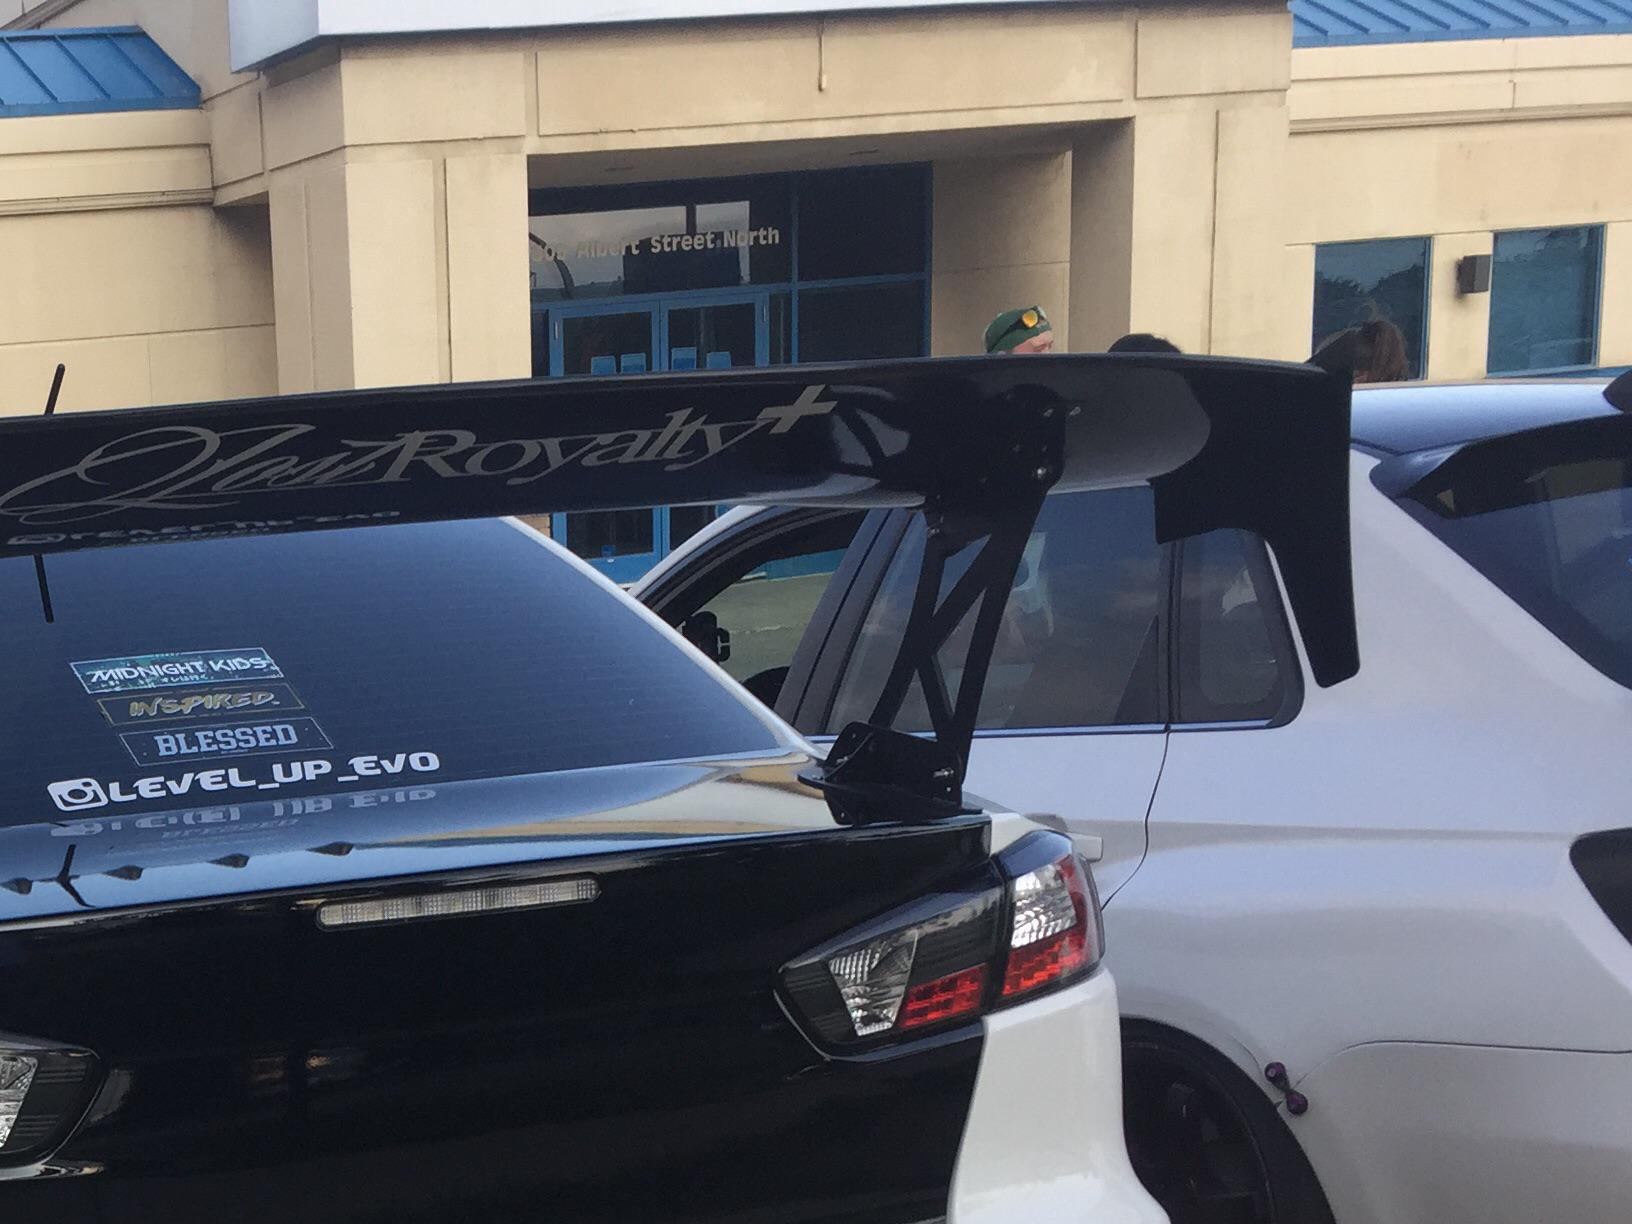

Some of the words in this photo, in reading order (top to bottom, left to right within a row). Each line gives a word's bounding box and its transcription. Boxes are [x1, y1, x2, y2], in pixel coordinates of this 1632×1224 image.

[650, 231, 715, 254] Street
[722, 226, 780, 248] North
[86, 657, 205, 683] MIDNIGHT
[209, 656, 269, 674] KIDS
[153, 724, 299, 757] BLESSED
